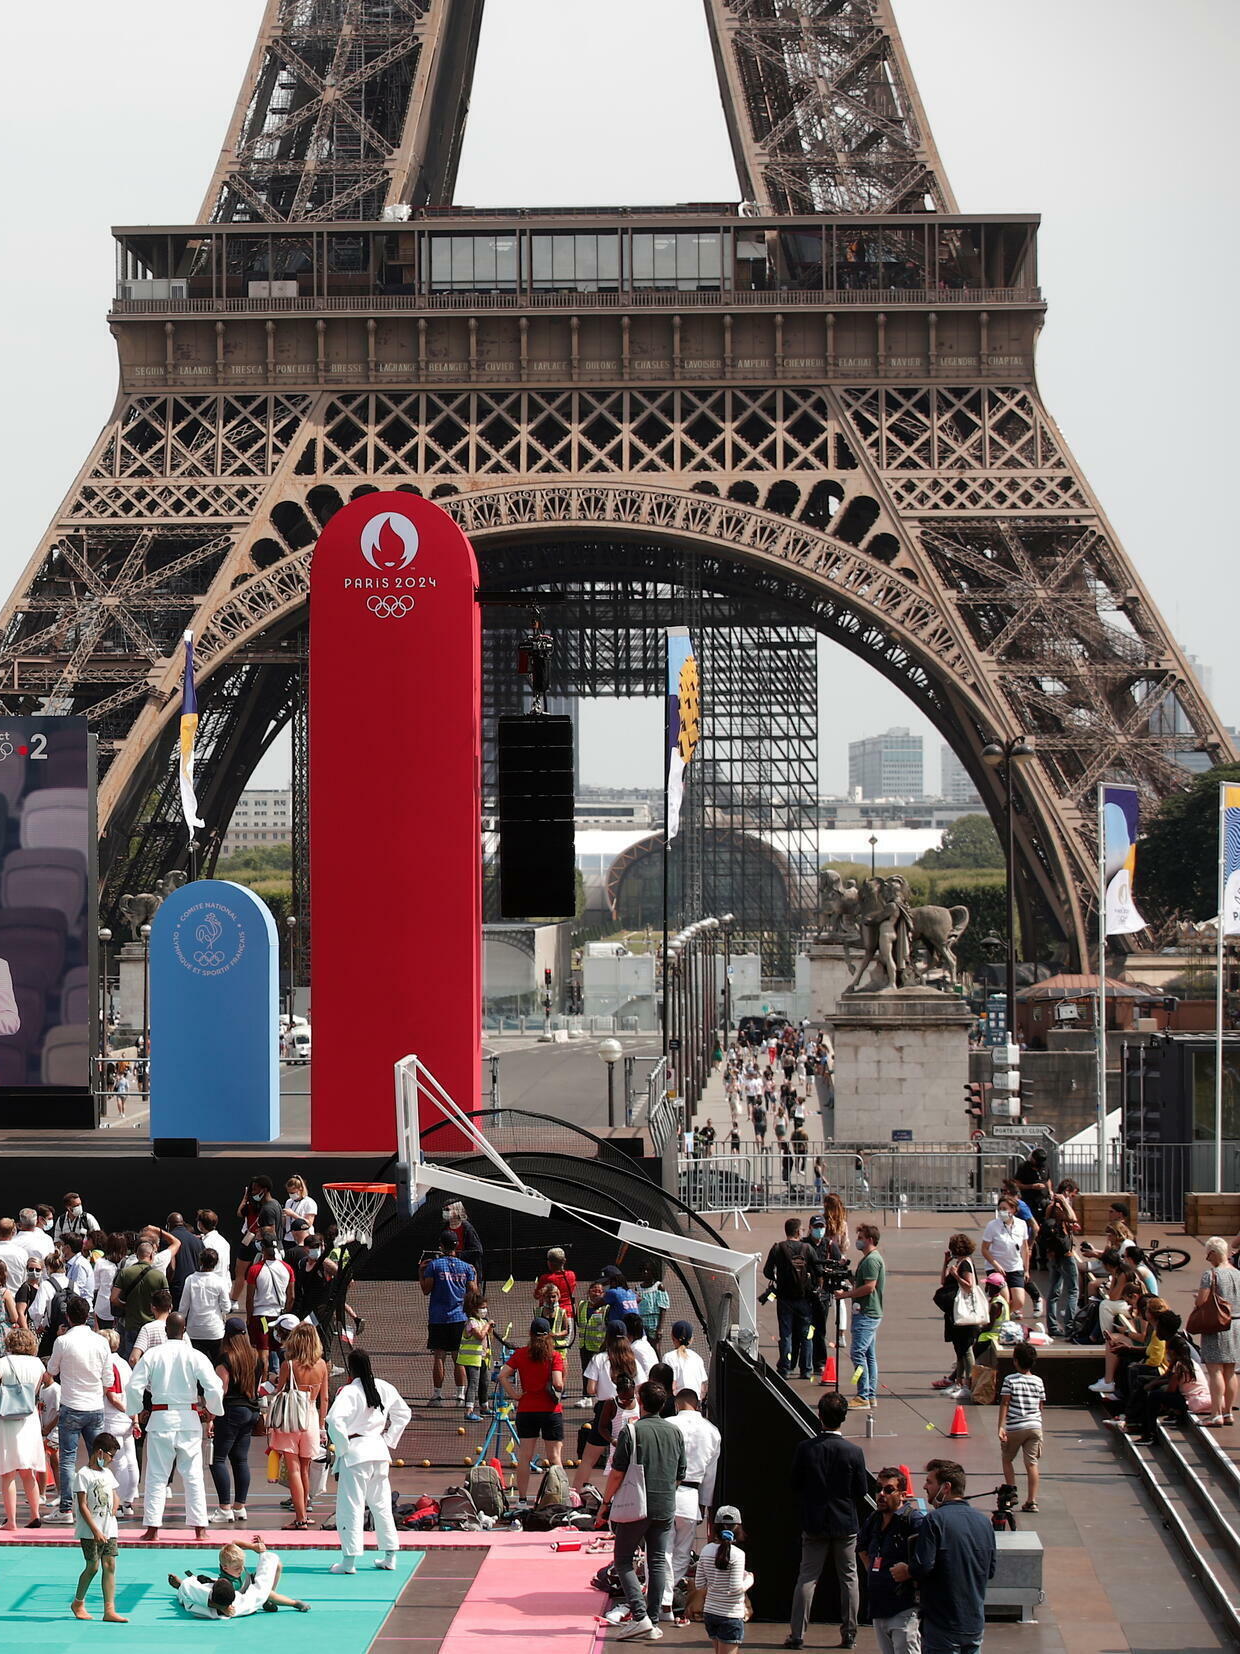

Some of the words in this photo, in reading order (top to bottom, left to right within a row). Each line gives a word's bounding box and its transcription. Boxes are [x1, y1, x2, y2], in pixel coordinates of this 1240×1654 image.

[635, 361, 670, 369] CHASLES
[684, 360, 722, 369] LAVOISIER
[738, 359, 770, 369] AMPERE
[891, 357, 921, 366] NAVIER
[940, 357, 977, 366] LEGENDRE
[988, 356, 1024, 365] CHAPTAL
[231, 365, 263, 374] TRESCA
[276, 364, 316, 373] PONCELET
[331, 363, 362, 373] BRESSE
[380, 363, 416, 372] LAGRANGE
[429, 363, 469, 371] BELANGER
[485, 362, 514, 371] CUVIER
[534, 361, 566, 370] LAPLACE
[135, 366, 164, 376] SEGUIN
[180, 366, 213, 375] LALANDE
[344, 578, 389, 588] PARIS
[395, 577, 437, 588] 2024
[30, 733, 48, 759] 2
[205, 902, 237, 921] NATIONAL
[173, 931, 193, 969] OLYMPIQUE
[192, 967, 201, 975] ET
[202, 964, 230, 976] SPORTIF
